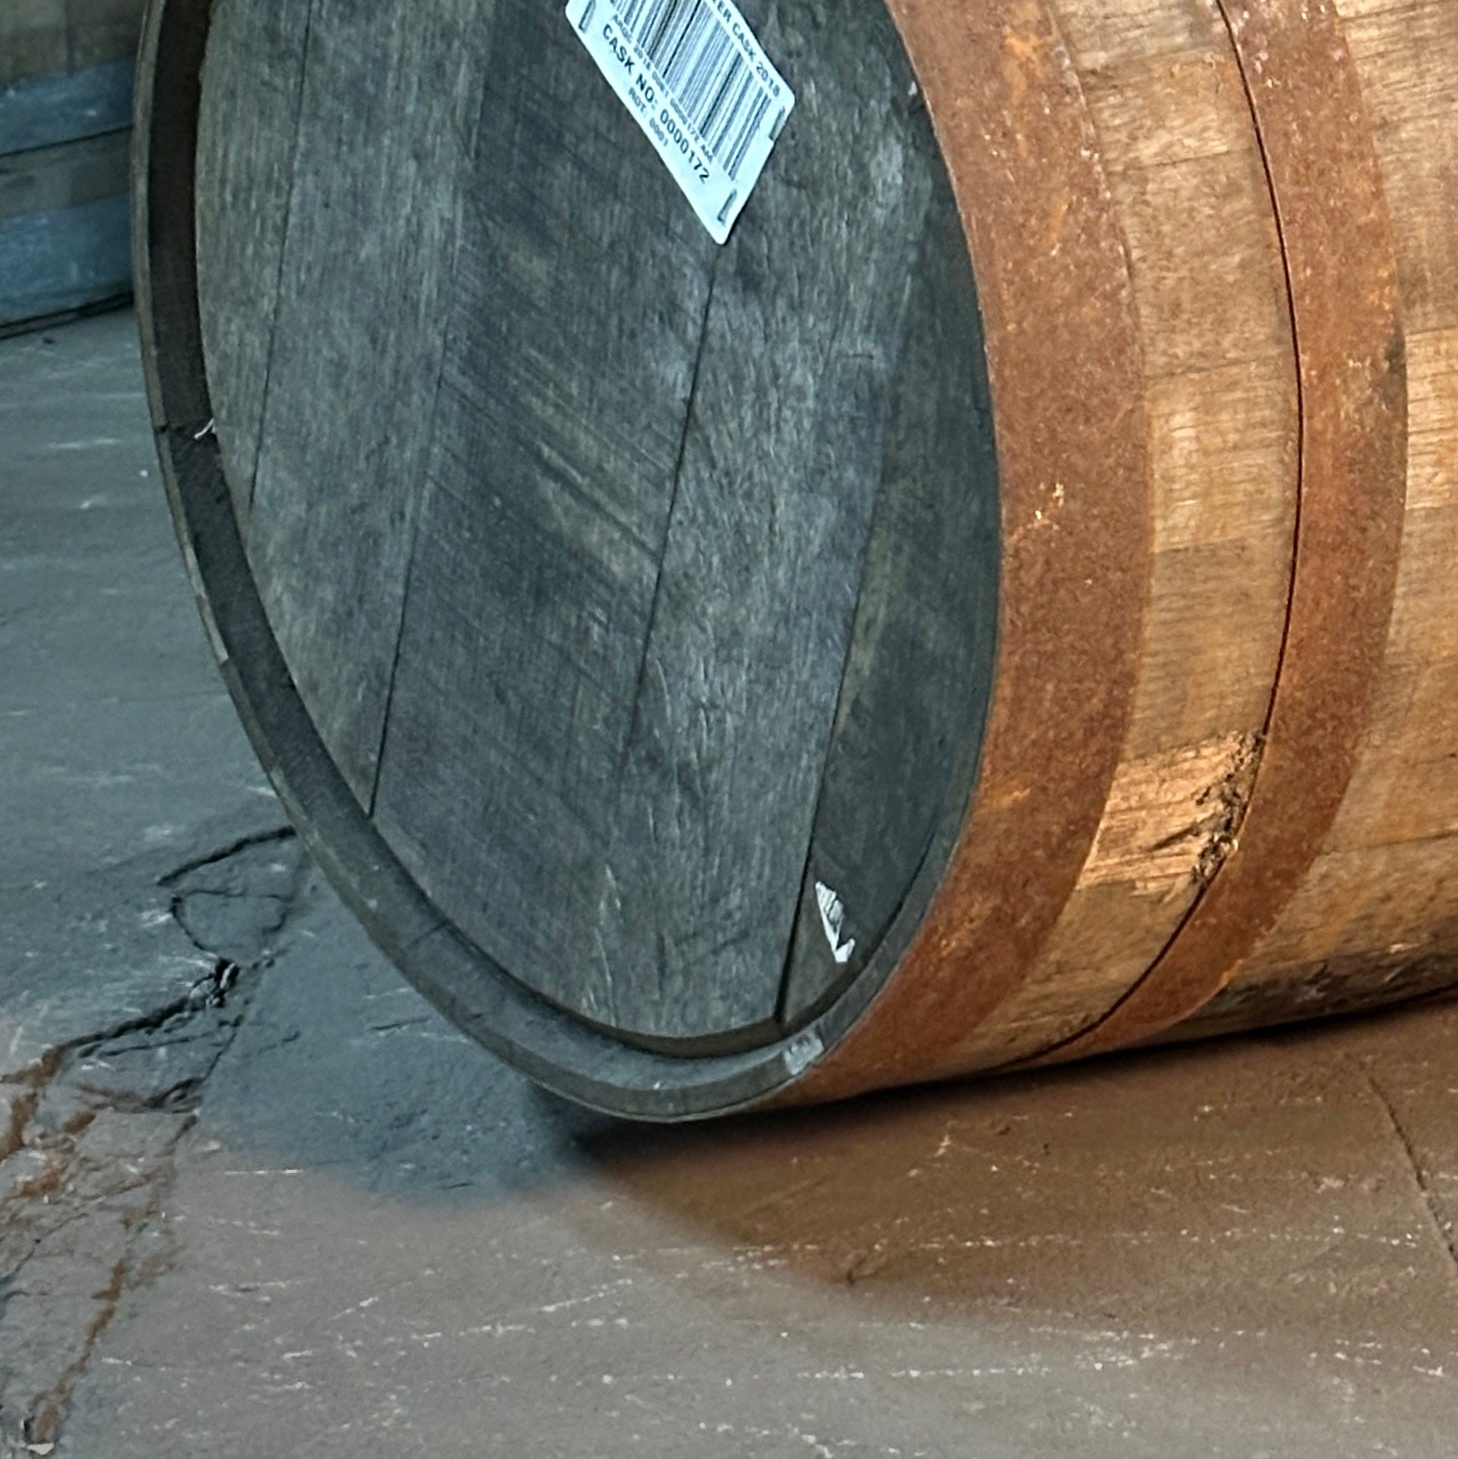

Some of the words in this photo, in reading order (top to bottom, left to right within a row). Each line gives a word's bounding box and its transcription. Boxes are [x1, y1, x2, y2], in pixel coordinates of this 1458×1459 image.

[603, 24, 635, 75] CASK
[636, 73, 658, 110] NO:
[660, 109, 709, 184] 0000172
[733, 23, 756, 62] CASK
[756, 61, 780, 97] 2018
